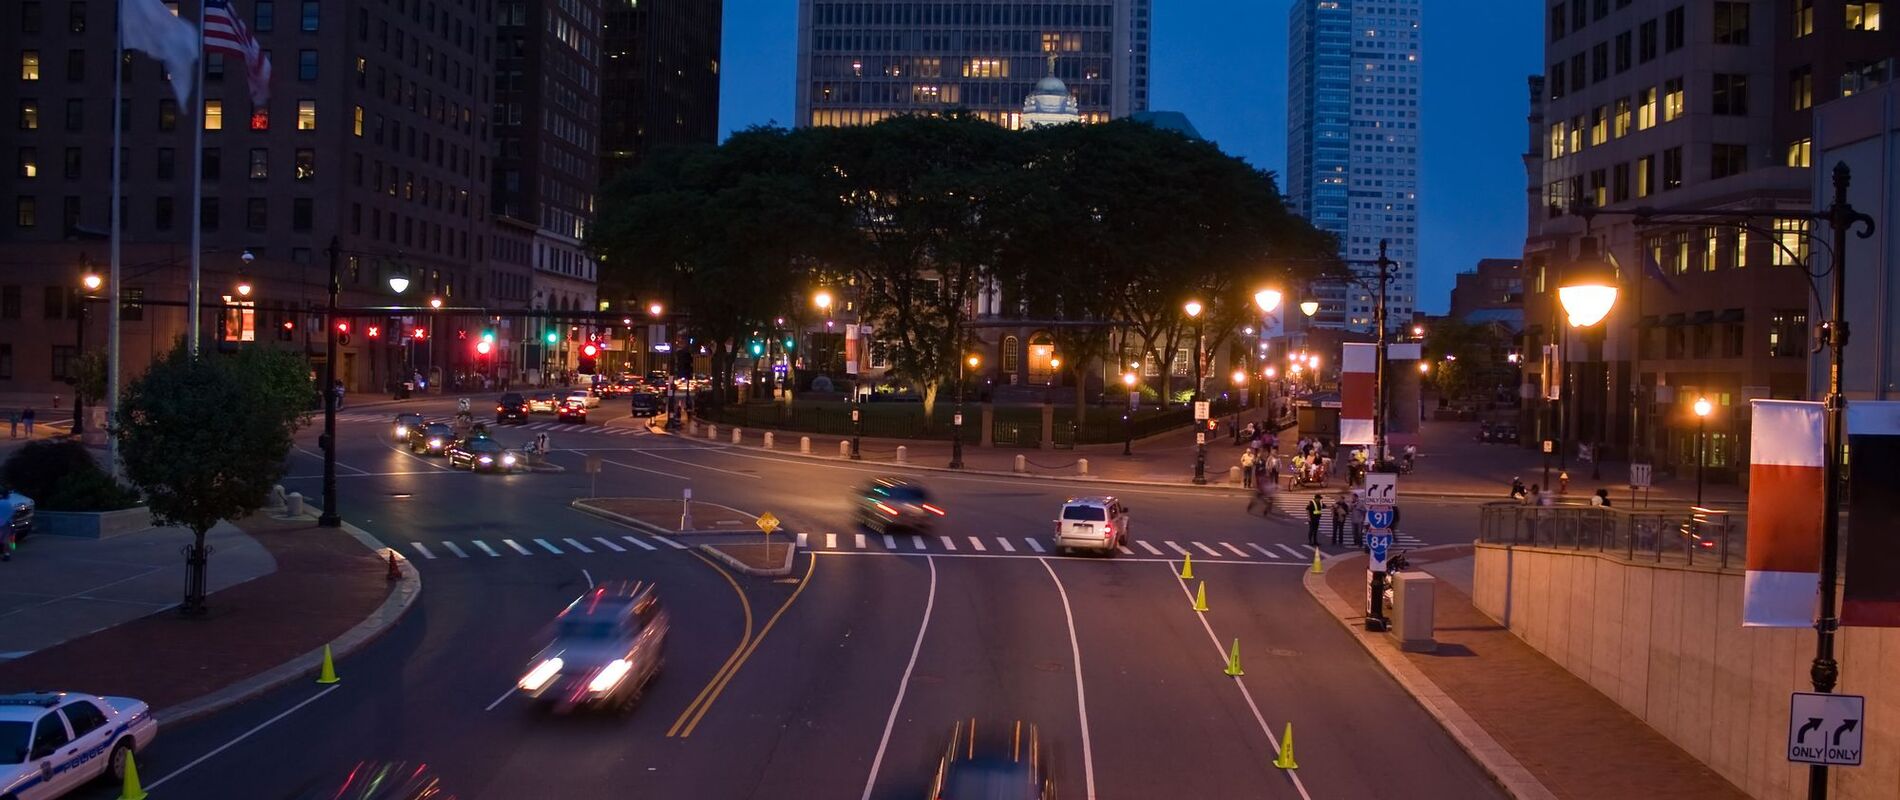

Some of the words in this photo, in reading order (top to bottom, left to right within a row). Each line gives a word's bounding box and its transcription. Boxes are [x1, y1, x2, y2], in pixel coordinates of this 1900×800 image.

[1374, 512, 1388, 525] 91
[1370, 536, 1388, 549] 84
[63, 744, 105, 774] POLICE
[1792, 746, 1824, 759] ONLY
[1828, 748, 1859, 760] ONLY
